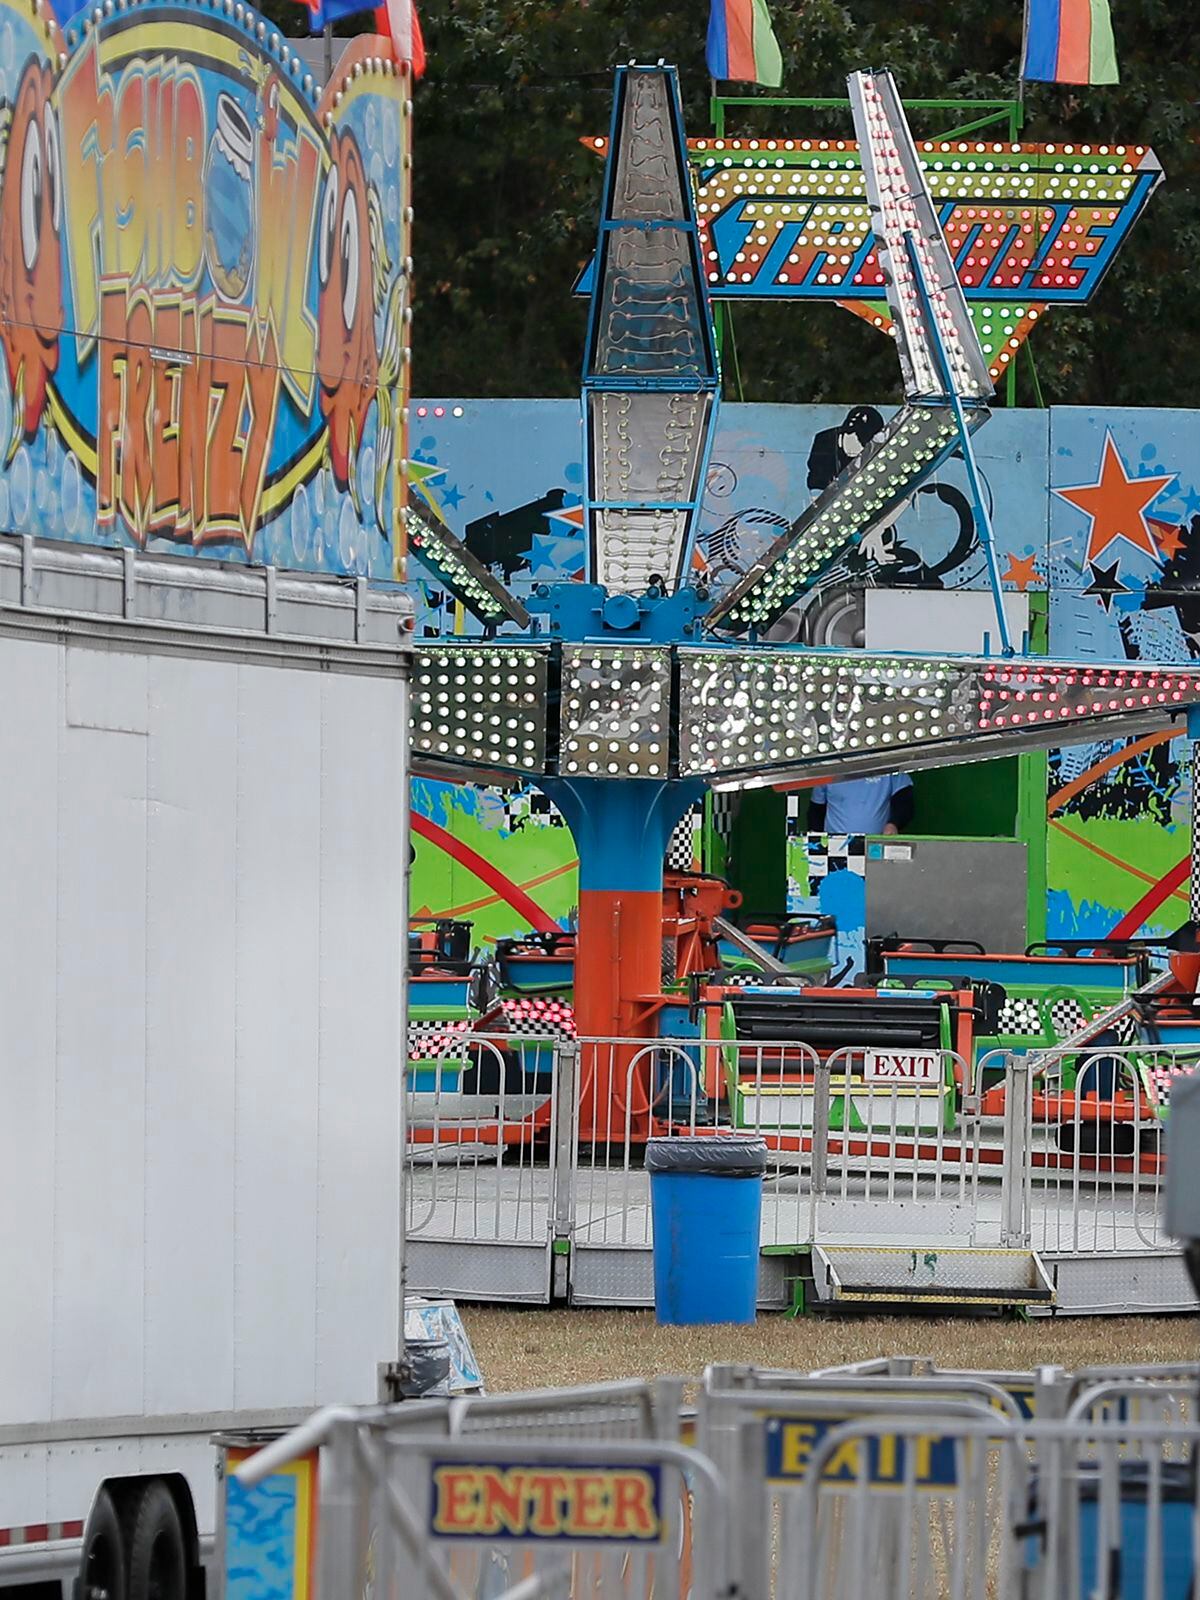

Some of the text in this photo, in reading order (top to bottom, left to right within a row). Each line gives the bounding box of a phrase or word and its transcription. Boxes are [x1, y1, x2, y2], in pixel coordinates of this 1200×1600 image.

[97, 274, 279, 552] FRENZY
[873, 1055, 934, 1078] EXIT
[436, 1468, 656, 1535] ENTER
